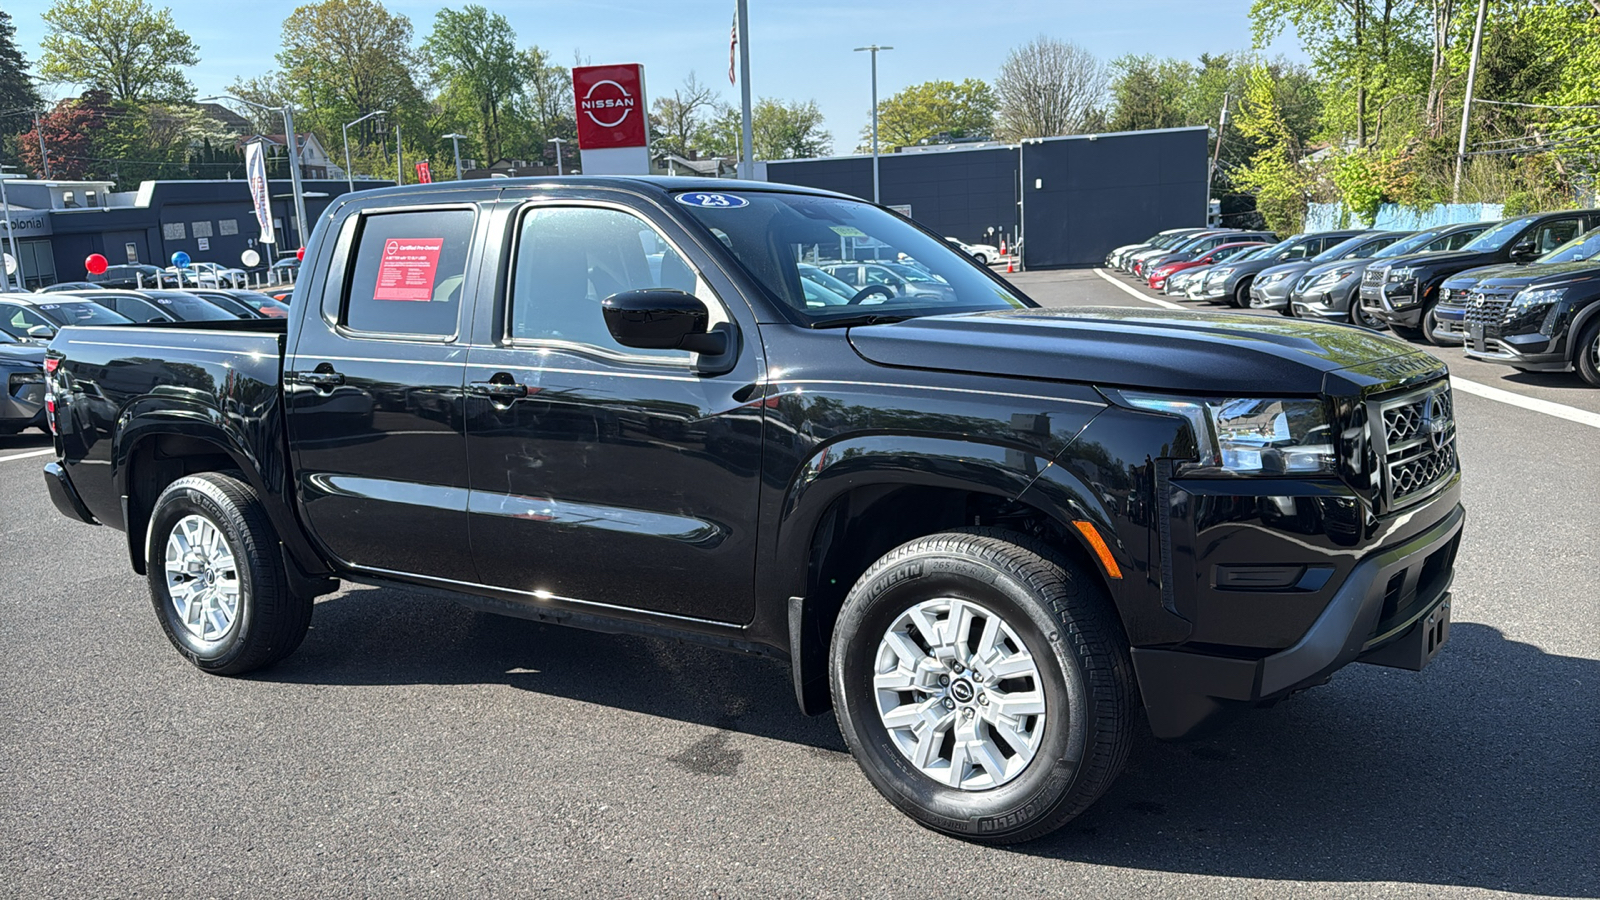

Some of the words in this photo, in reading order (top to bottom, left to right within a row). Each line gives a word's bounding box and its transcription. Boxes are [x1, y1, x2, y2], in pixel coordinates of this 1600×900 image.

[581, 98, 634, 109] NISSAN
[696, 194, 730, 206] 23
[860, 562, 922, 610] MICHELIN
[980, 788, 1053, 832] MICHELIN
